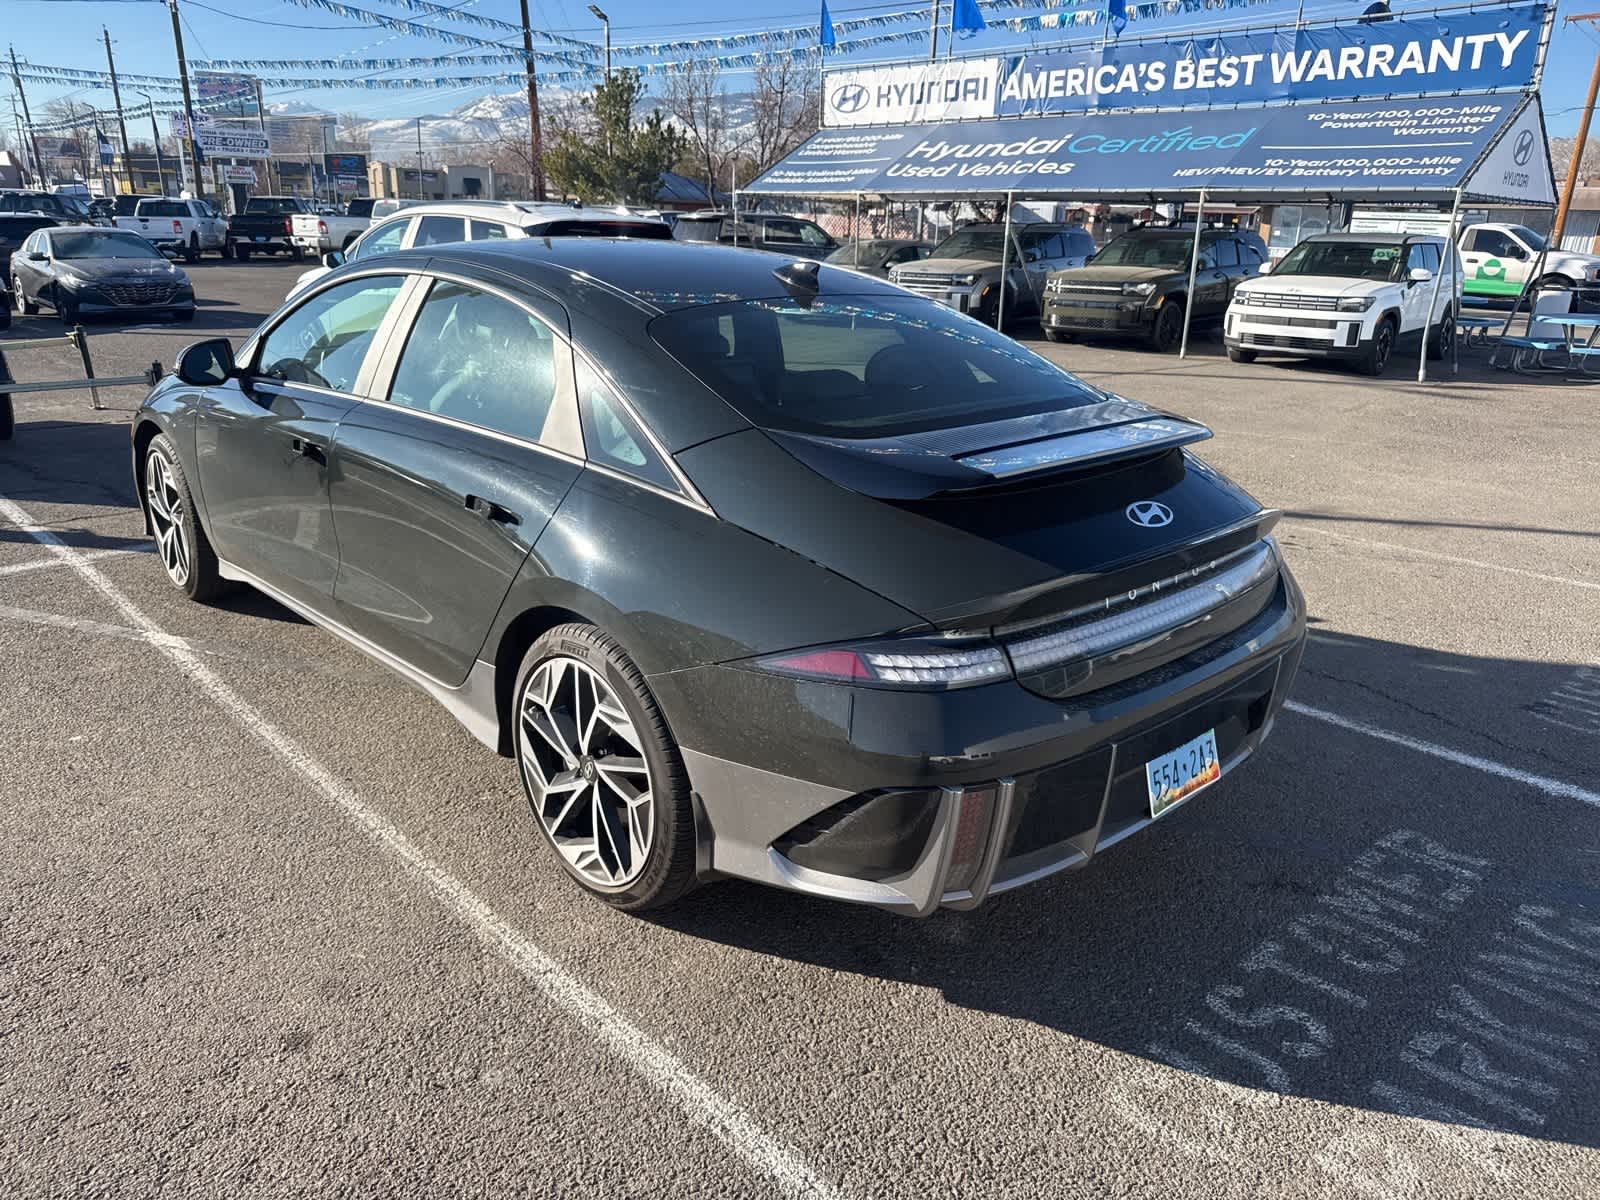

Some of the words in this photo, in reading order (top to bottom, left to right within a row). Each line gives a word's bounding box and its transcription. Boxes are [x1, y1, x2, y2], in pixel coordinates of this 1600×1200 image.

[1001, 62, 1166, 101] AMERICA'S
[1173, 54, 1263, 91] BEST
[1269, 29, 1530, 84] WARRANTY
[876, 76, 988, 108] HYUNDAI
[1307, 103, 1502, 121] 10-Year/100,000-Mile
[1320, 117, 1418, 129] Powertrain
[1421, 114, 1496, 126] Limited
[1393, 125, 1484, 136] Warranty
[201, 136, 267, 148] PRE-OWNED
[906, 133, 1074, 162] Hyundai
[1068, 126, 1257, 154] Certified
[886, 163, 958, 178] Used
[957, 158, 1076, 178] Vehicles
[1264, 156, 1462, 168] 10-Year/100,000-Mile
[1290, 167, 1359, 177] Battery
[1362, 166, 1456, 177] Warranty
